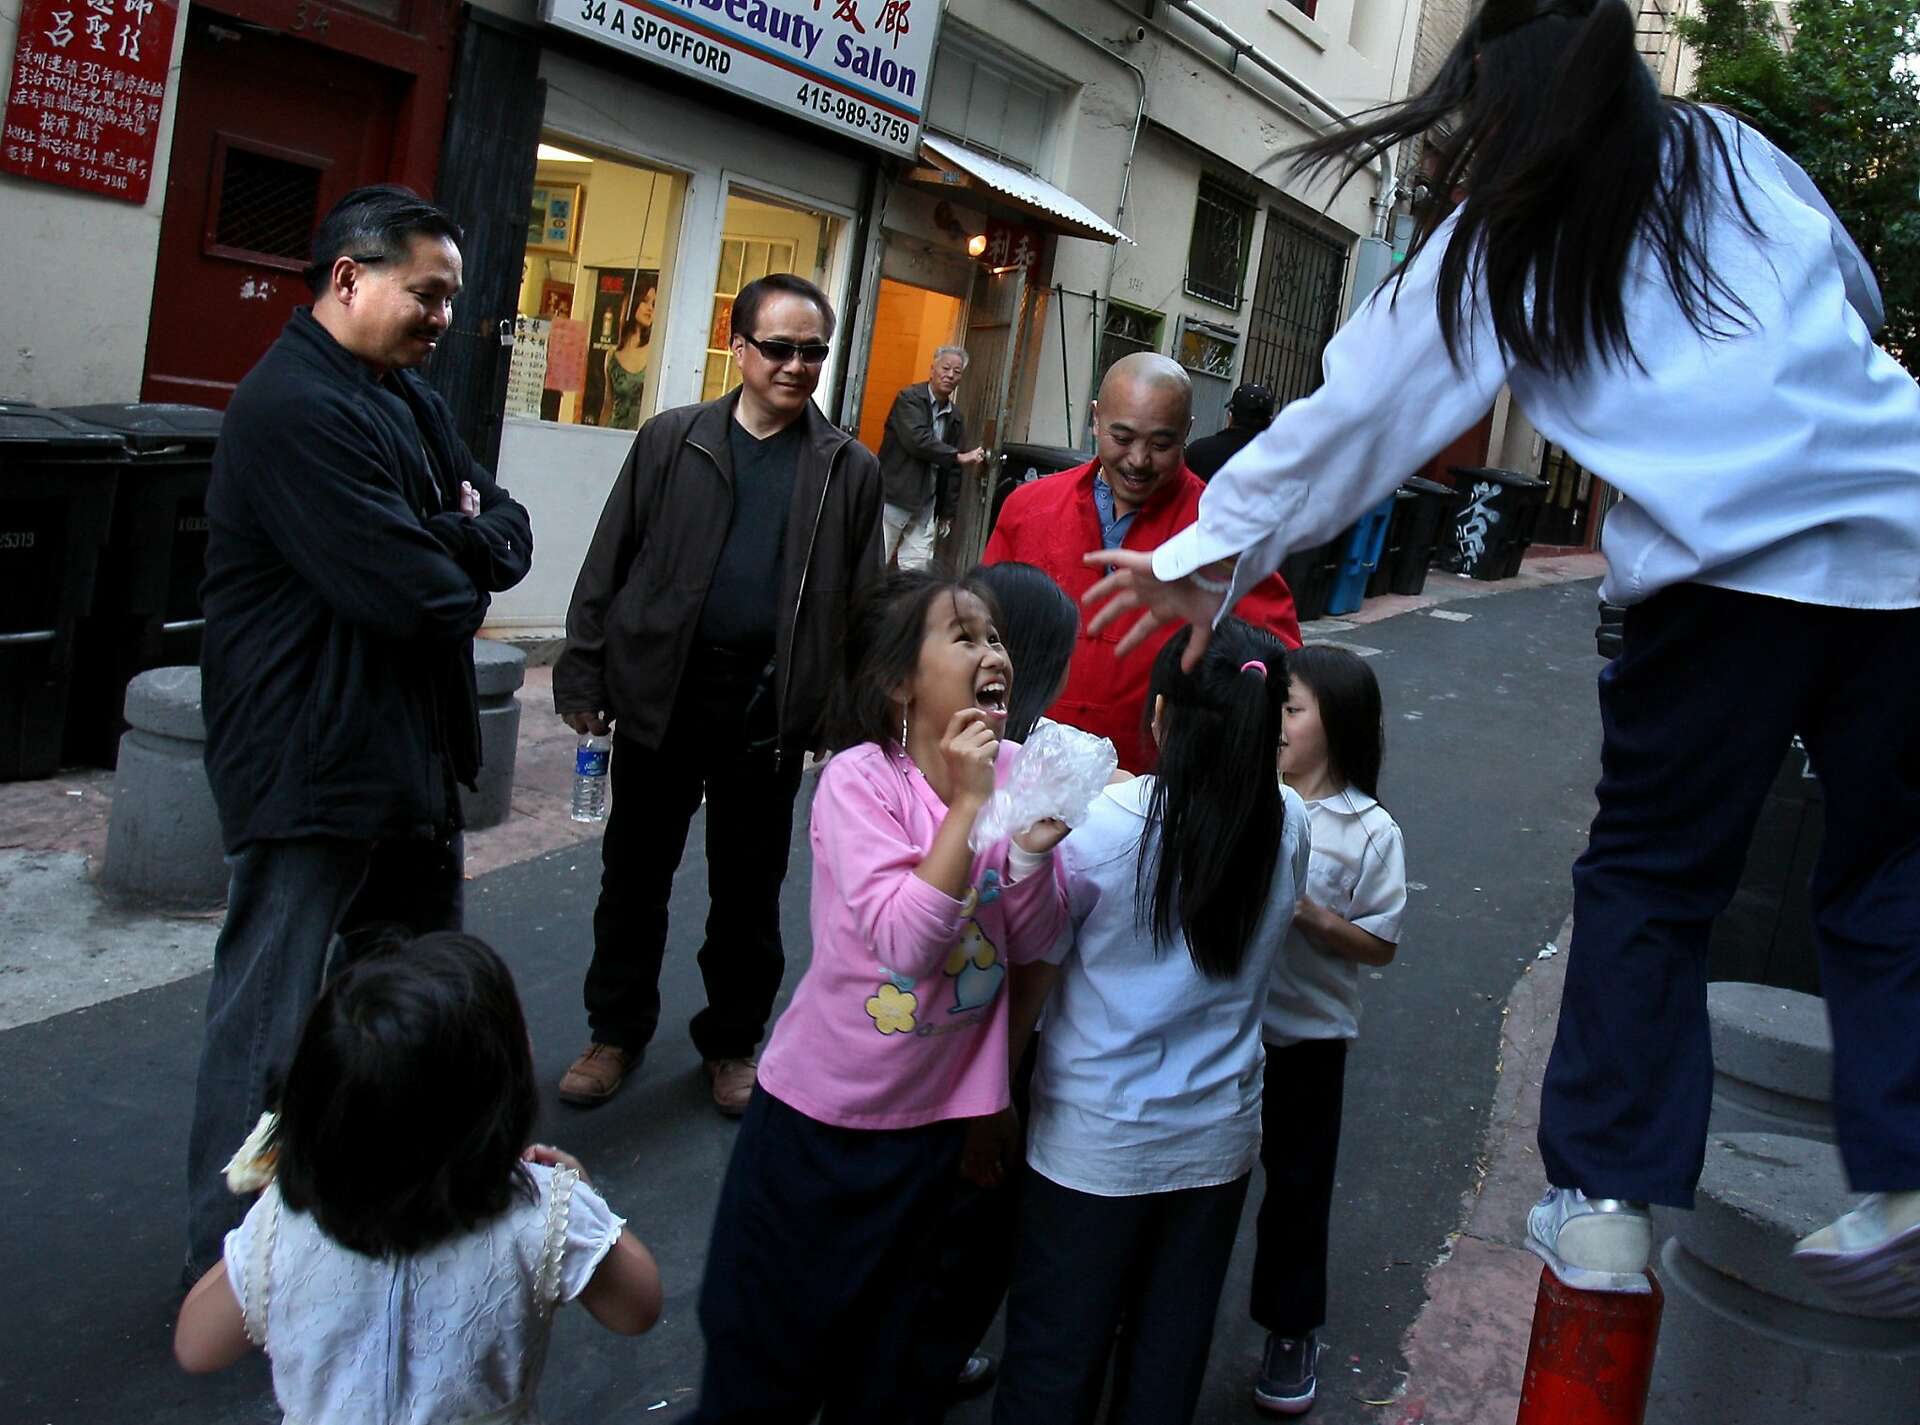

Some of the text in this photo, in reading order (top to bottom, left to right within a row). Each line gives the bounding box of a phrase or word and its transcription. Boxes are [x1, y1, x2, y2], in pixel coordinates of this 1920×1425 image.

[581, 0, 731, 74] 34 A SPOFFORD
[834, 34, 917, 97] Salon
[797, 82, 910, 144] 415-989-3759
